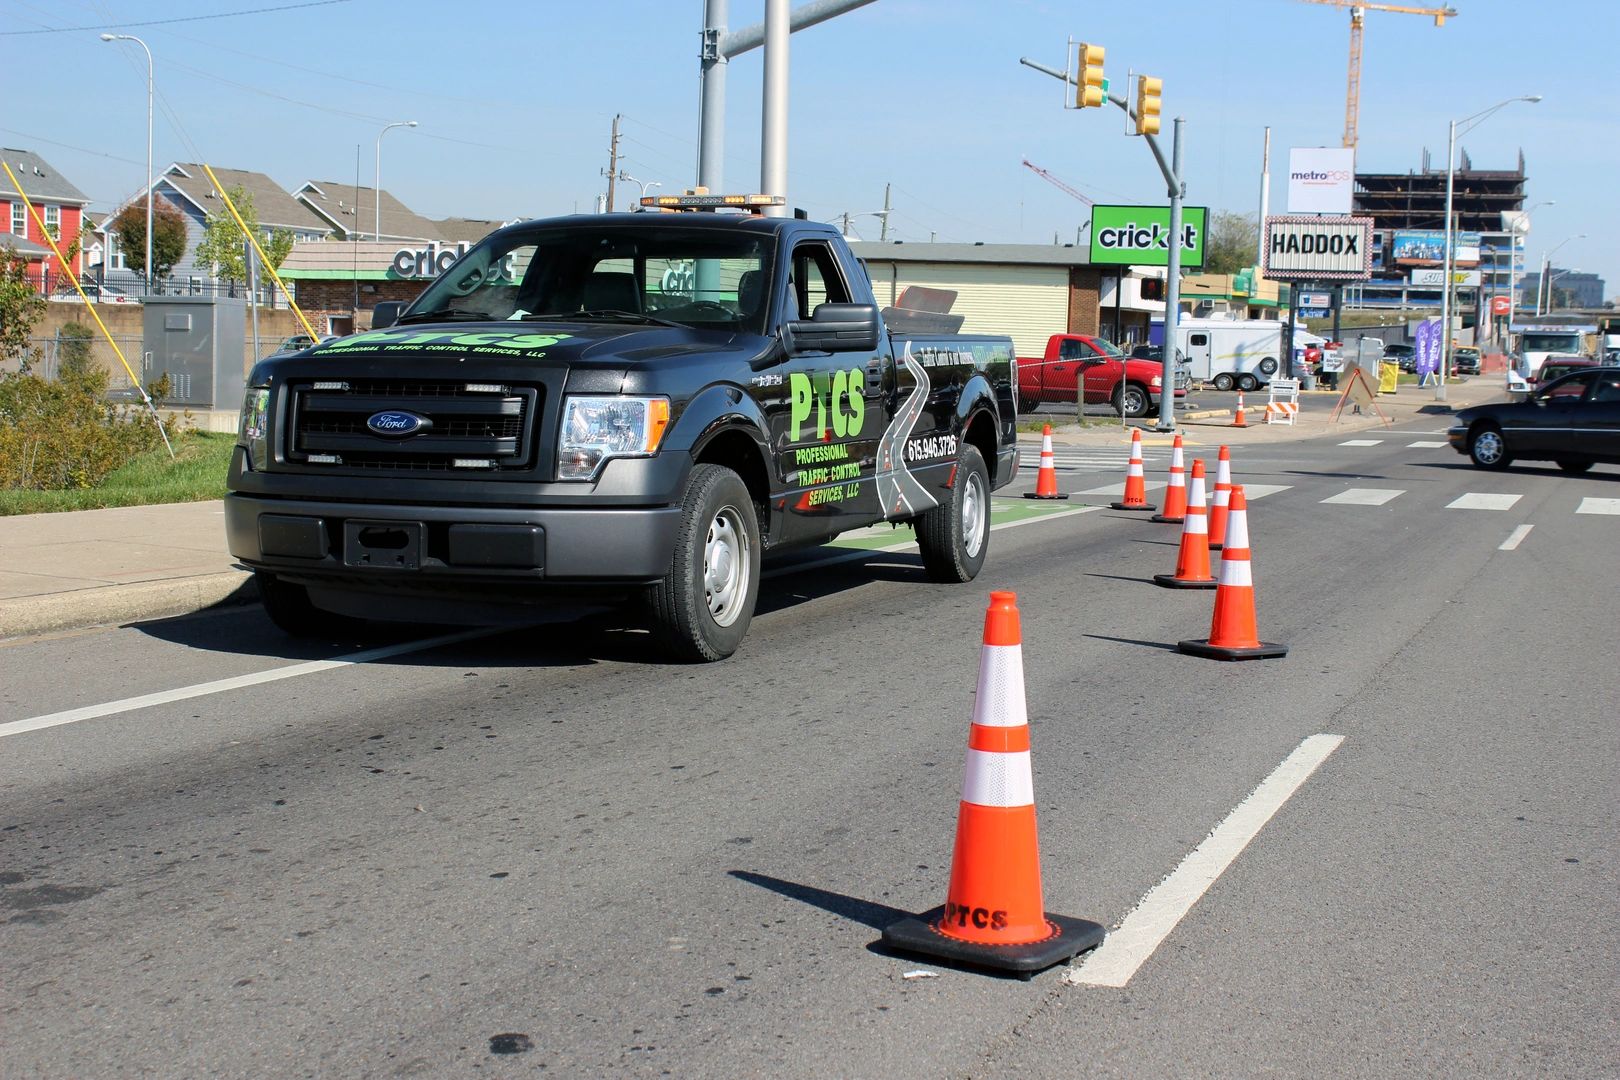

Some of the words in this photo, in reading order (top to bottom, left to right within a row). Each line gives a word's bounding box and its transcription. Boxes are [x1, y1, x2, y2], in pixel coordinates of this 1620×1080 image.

[1291, 170, 1350, 181] metroPCS
[1272, 233, 1358, 255] HADDOX
[393, 240, 518, 281] crict
[312, 346, 379, 355] PROFESSIONAL
[472, 346, 521, 356] SERVICES,
[328, 333, 574, 349] PTCS
[789, 367, 865, 442] PTCS
[377, 414, 408, 429] Ford
[795, 443, 849, 465] PROFESSIONAL
[908, 434, 957, 462] 615.946.3726
[798, 467, 829, 487] TRAFFIC
[831, 462, 861, 482] CONTROL
[808, 486, 844, 506] SERVICES,
[846, 482, 860, 498] LLC
[945, 902, 1008, 931] PTCS
